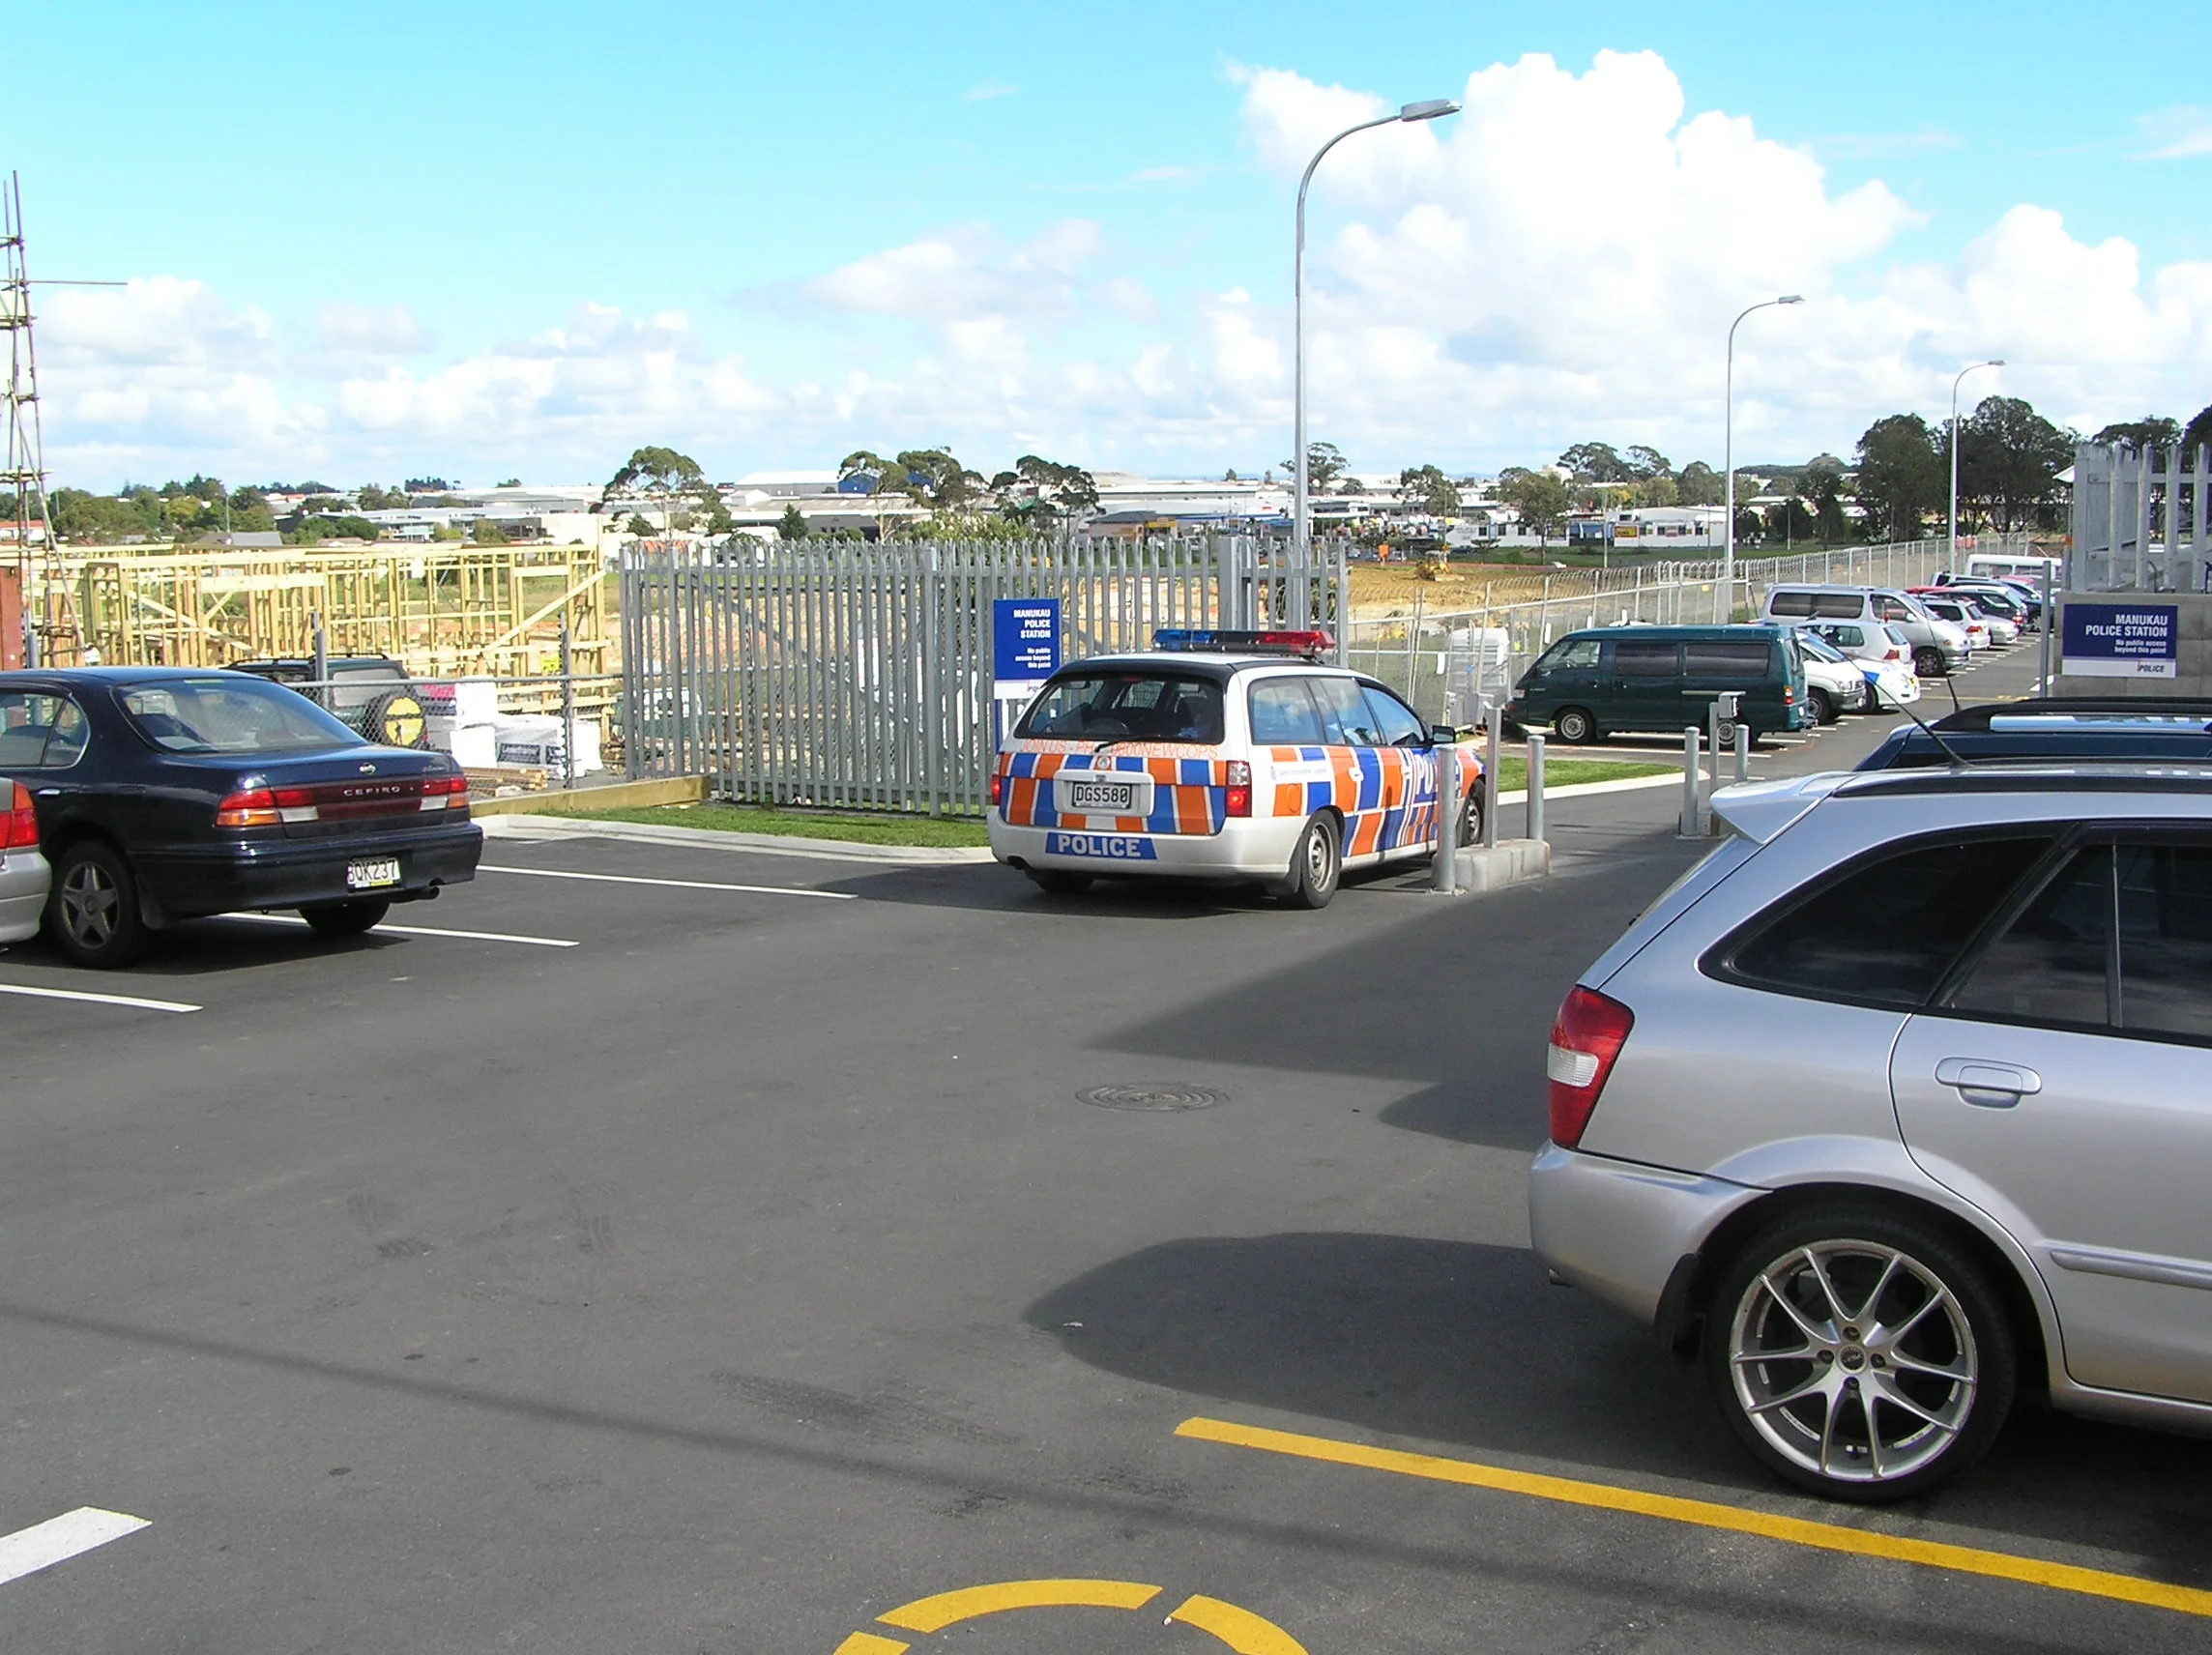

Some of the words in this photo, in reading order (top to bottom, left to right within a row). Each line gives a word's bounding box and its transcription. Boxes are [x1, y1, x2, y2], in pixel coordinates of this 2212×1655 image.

[1013, 609, 1051, 619] MANUKAU
[2115, 614, 2168, 625] MANUKAU
[1024, 620, 1051, 628] POLICE
[1020, 629, 1051, 639] STATION
[2085, 625, 2122, 636] POLICE
[2124, 626, 2168, 637] STATION
[2136, 660, 2165, 673] POLICE
[343, 786, 400, 797] CEFIRO
[1076, 786, 1128, 803] DGS580
[1058, 834, 1141, 857] POLICE
[347, 860, 395, 882] BQK237
